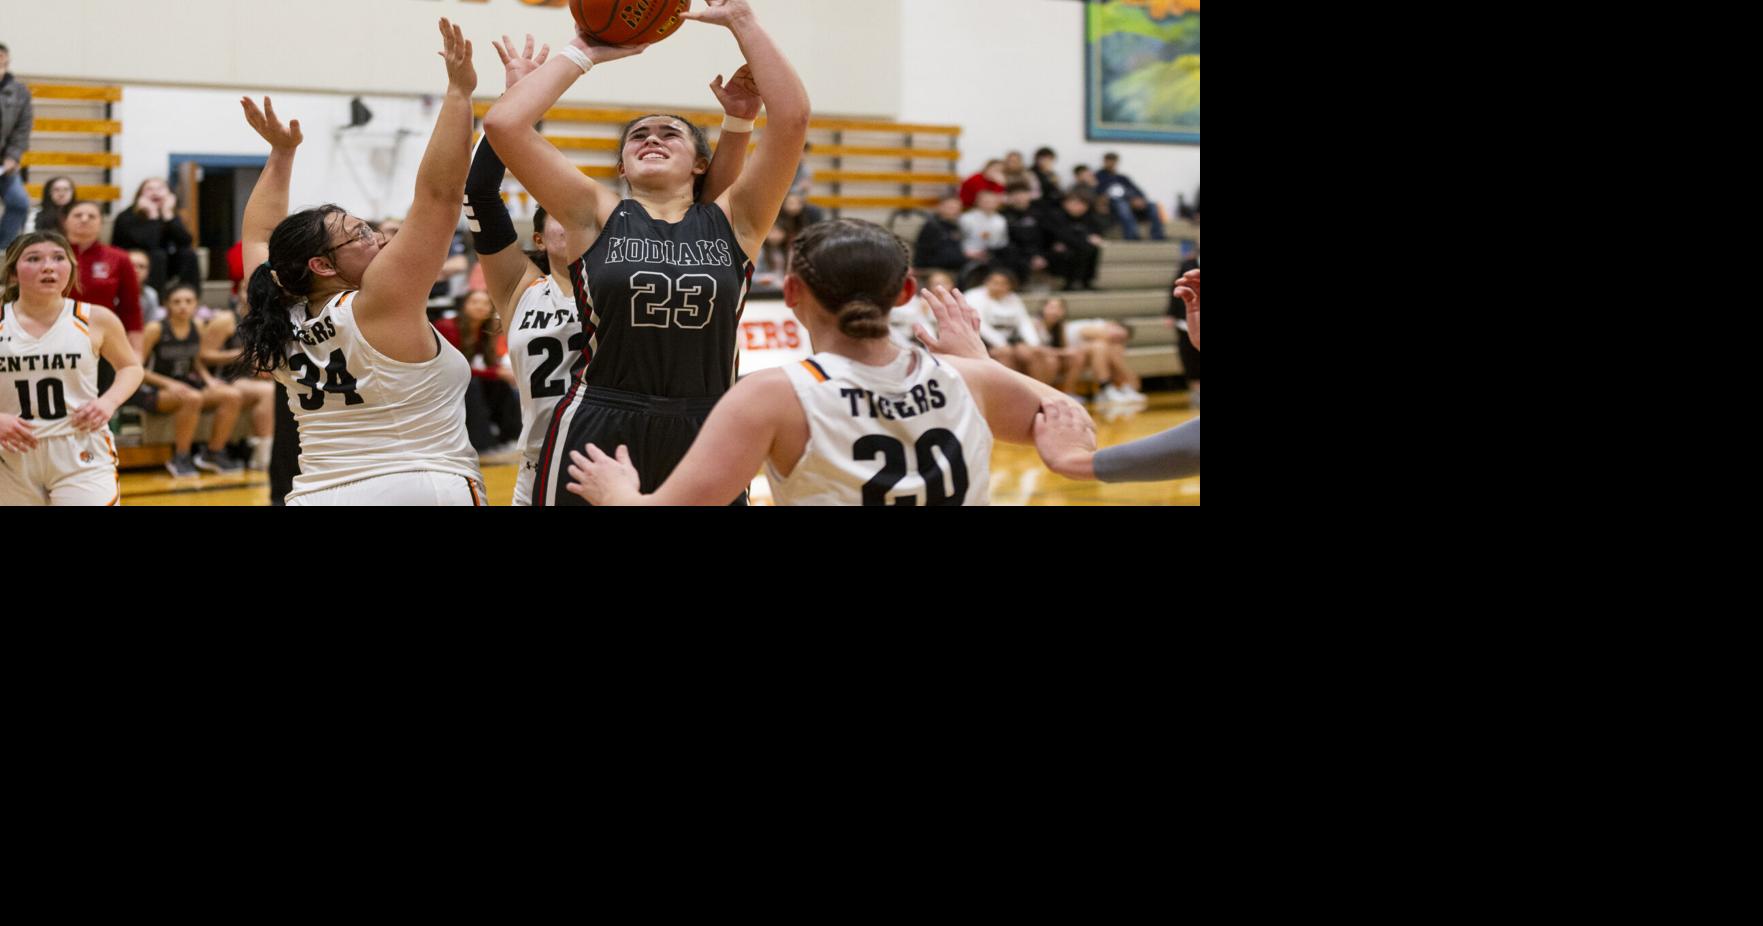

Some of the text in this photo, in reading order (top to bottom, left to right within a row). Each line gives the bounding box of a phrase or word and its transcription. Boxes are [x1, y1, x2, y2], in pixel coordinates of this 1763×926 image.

[605, 236, 732, 267] KODIAKS
[630, 270, 718, 329] 23
[740, 320, 801, 351] ERS
[15, 377, 67, 420] 10
[288, 347, 365, 411] 34
[840, 379, 946, 420] TIGERS
[853, 428, 969, 506] 20
